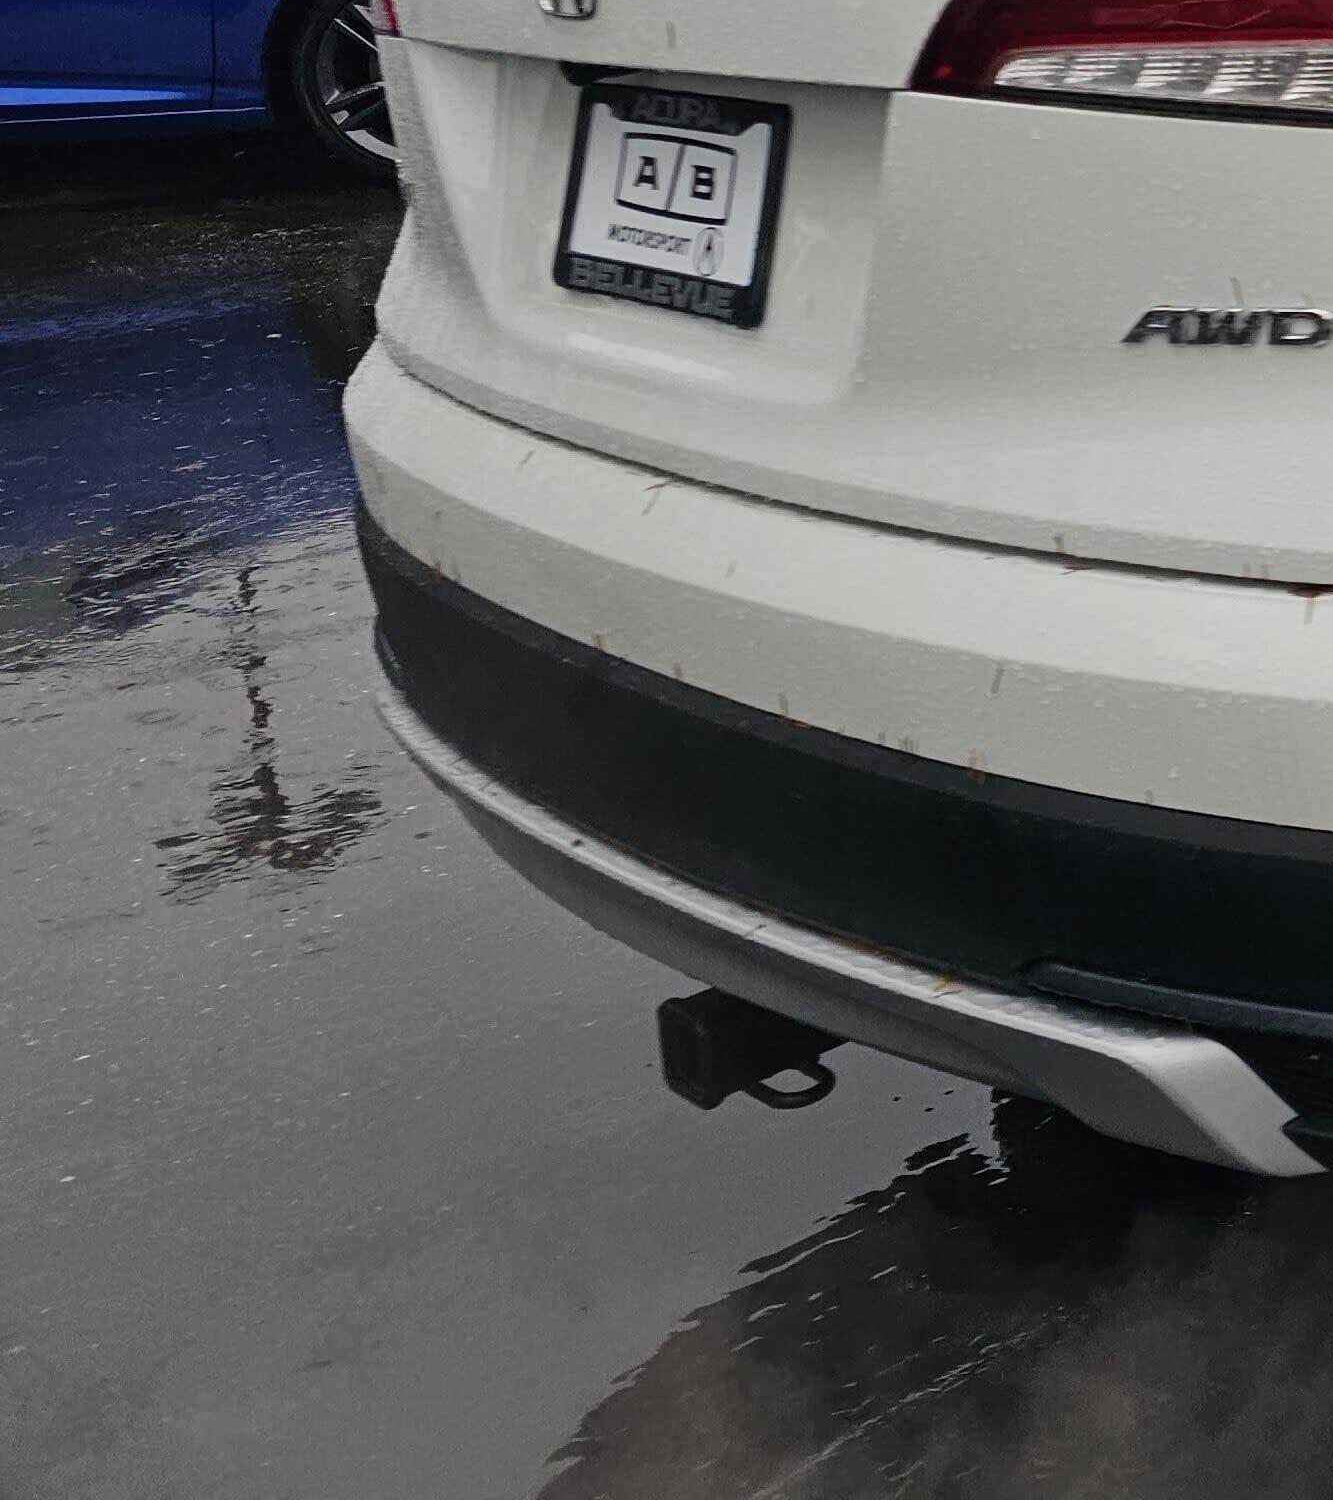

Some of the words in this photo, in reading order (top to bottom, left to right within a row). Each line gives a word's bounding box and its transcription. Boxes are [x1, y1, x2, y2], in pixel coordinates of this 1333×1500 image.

[632, 155, 660, 190] A
[689, 164, 716, 200] B
[569, 256, 734, 320] BELLEVUE
